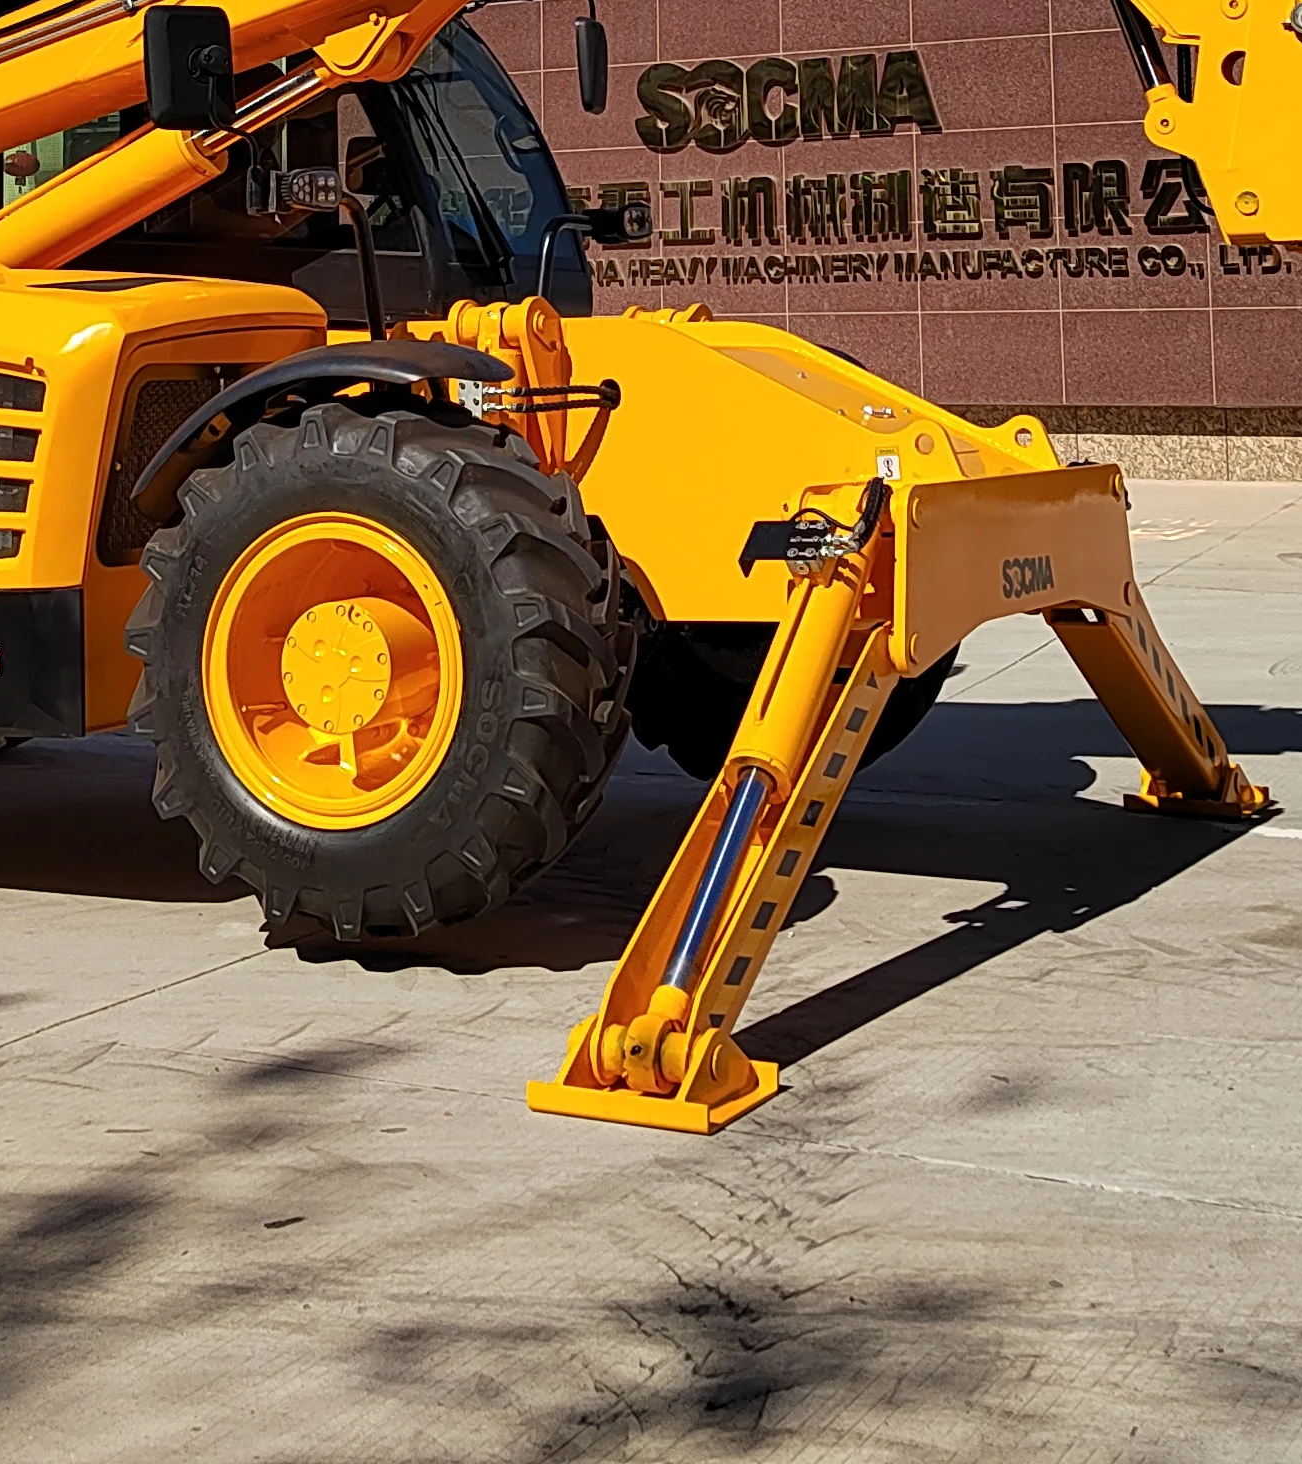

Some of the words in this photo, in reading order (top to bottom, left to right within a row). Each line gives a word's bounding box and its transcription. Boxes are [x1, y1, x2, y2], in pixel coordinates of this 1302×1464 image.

[635, 50, 944, 155] SOCMA
[627, 253, 718, 286] HEAVY
[720, 249, 890, 286] MACHINERY
[893, 244, 1130, 282] MANUFACTURE
[1002, 553, 1055, 600] SOCMA
